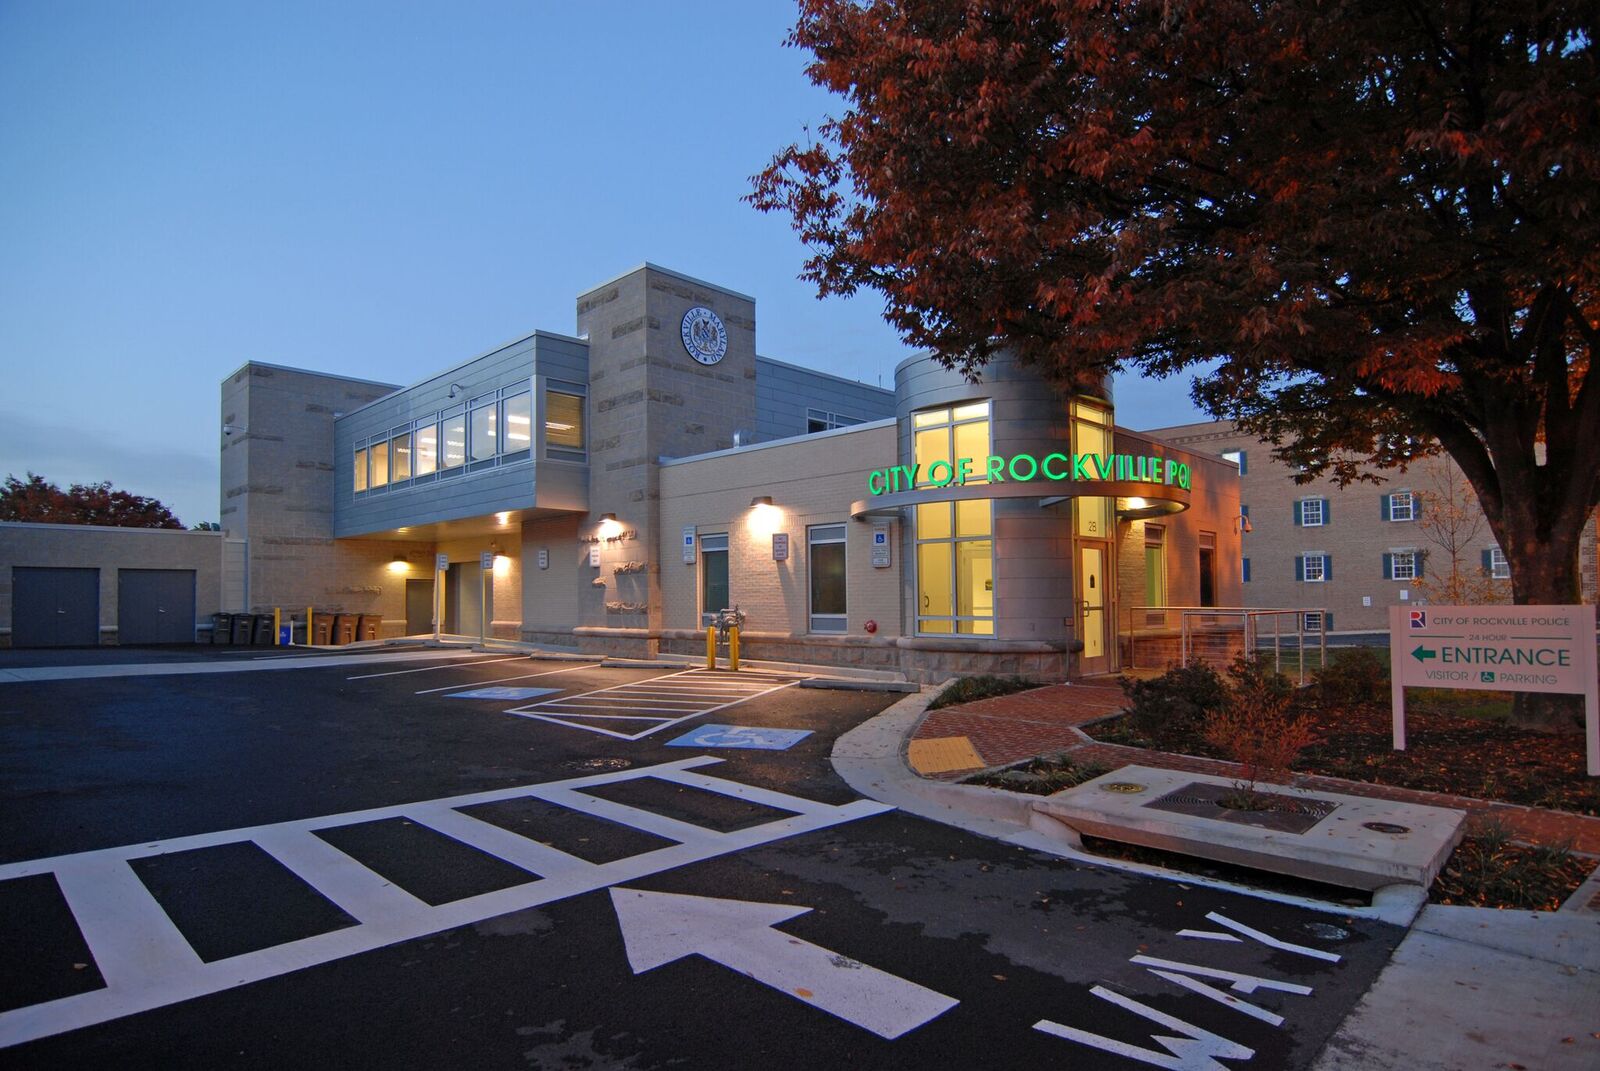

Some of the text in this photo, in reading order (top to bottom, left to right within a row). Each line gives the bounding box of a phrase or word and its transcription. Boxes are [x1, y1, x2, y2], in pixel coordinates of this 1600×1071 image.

[869, 463, 920, 496] CITY
[928, 457, 973, 488] OF
[987, 453, 1163, 484] ROCKVILLE
[1088, 521, 1097, 532] 28
[1433, 617, 1570, 626] CITY OF ROCKVILLE POLICE
[1482, 634, 1508, 642] HOUR
[1442, 647, 1571, 667] ENTRANCE
[1425, 670, 1469, 681] VISITOR
[1501, 672, 1558, 685] PARKING
[1032, 911, 1342, 1071] WAY
